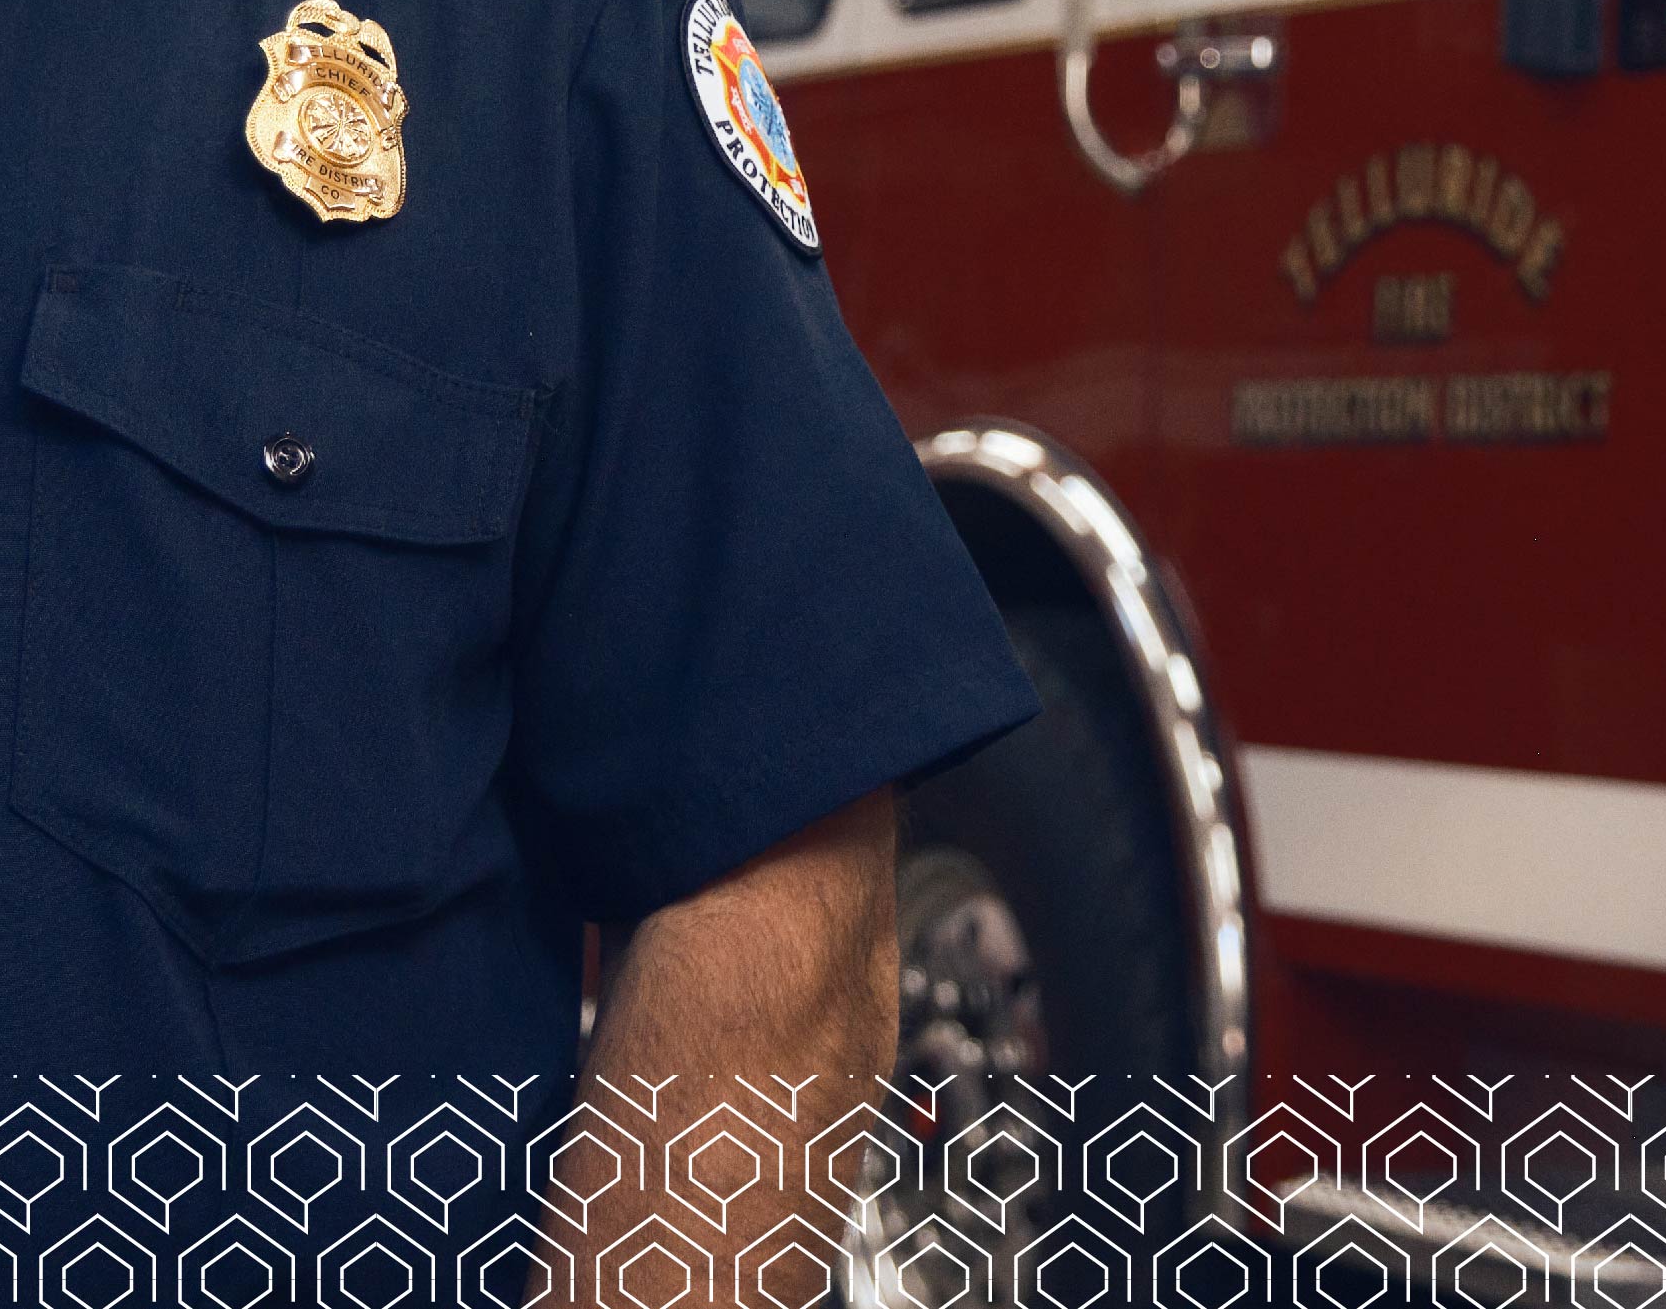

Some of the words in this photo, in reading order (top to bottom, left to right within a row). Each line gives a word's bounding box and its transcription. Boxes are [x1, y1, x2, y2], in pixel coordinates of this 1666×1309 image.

[306, 45, 384, 87] ELLURID
[315, 67, 371, 97] CHIEF
[291, 143, 314, 166] IRE
[321, 185, 340, 199] CO
[715, 119, 816, 242] PROTECTION
